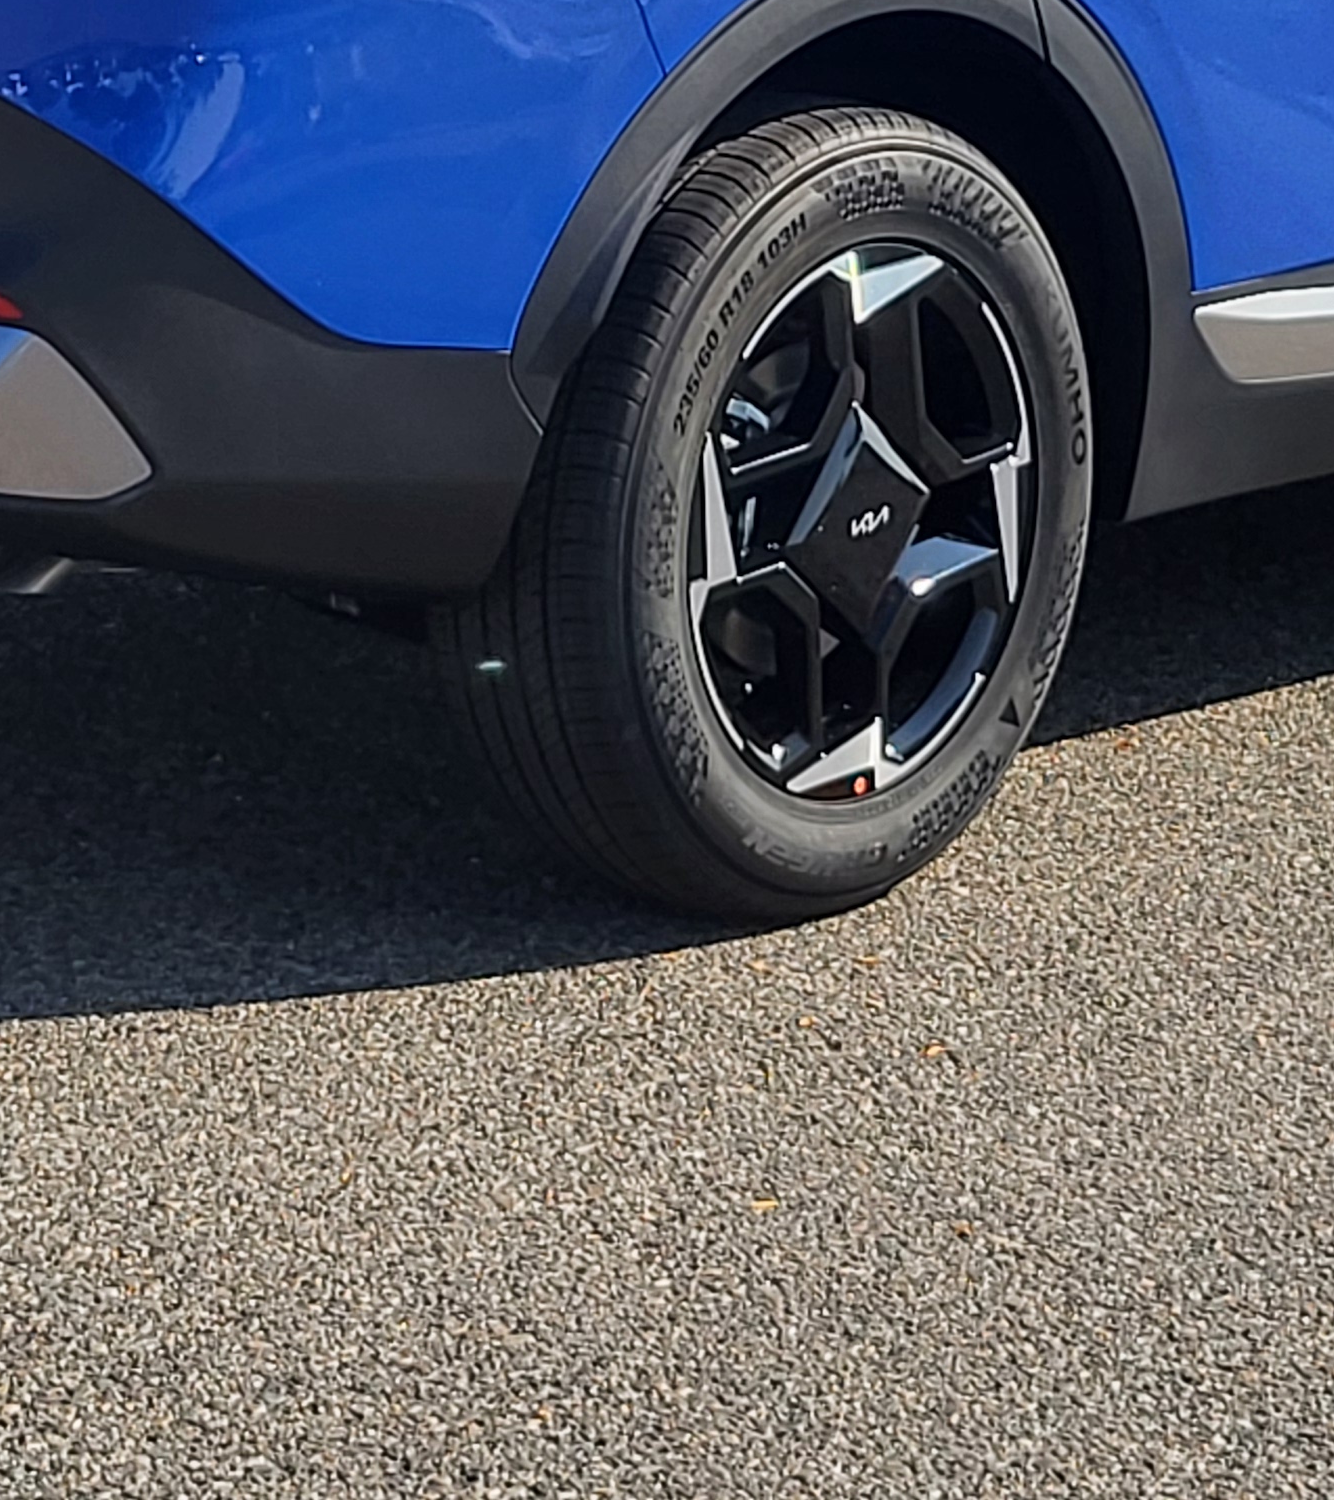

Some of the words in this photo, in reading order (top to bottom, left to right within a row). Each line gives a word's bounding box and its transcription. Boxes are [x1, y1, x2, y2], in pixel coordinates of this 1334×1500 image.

[673, 329, 719, 437] 235/60
[718, 270, 755, 328] R18
[756, 211, 808, 270] 103H
[851, 505, 890, 537] KIA
[741, 827, 888, 876] CGEN
